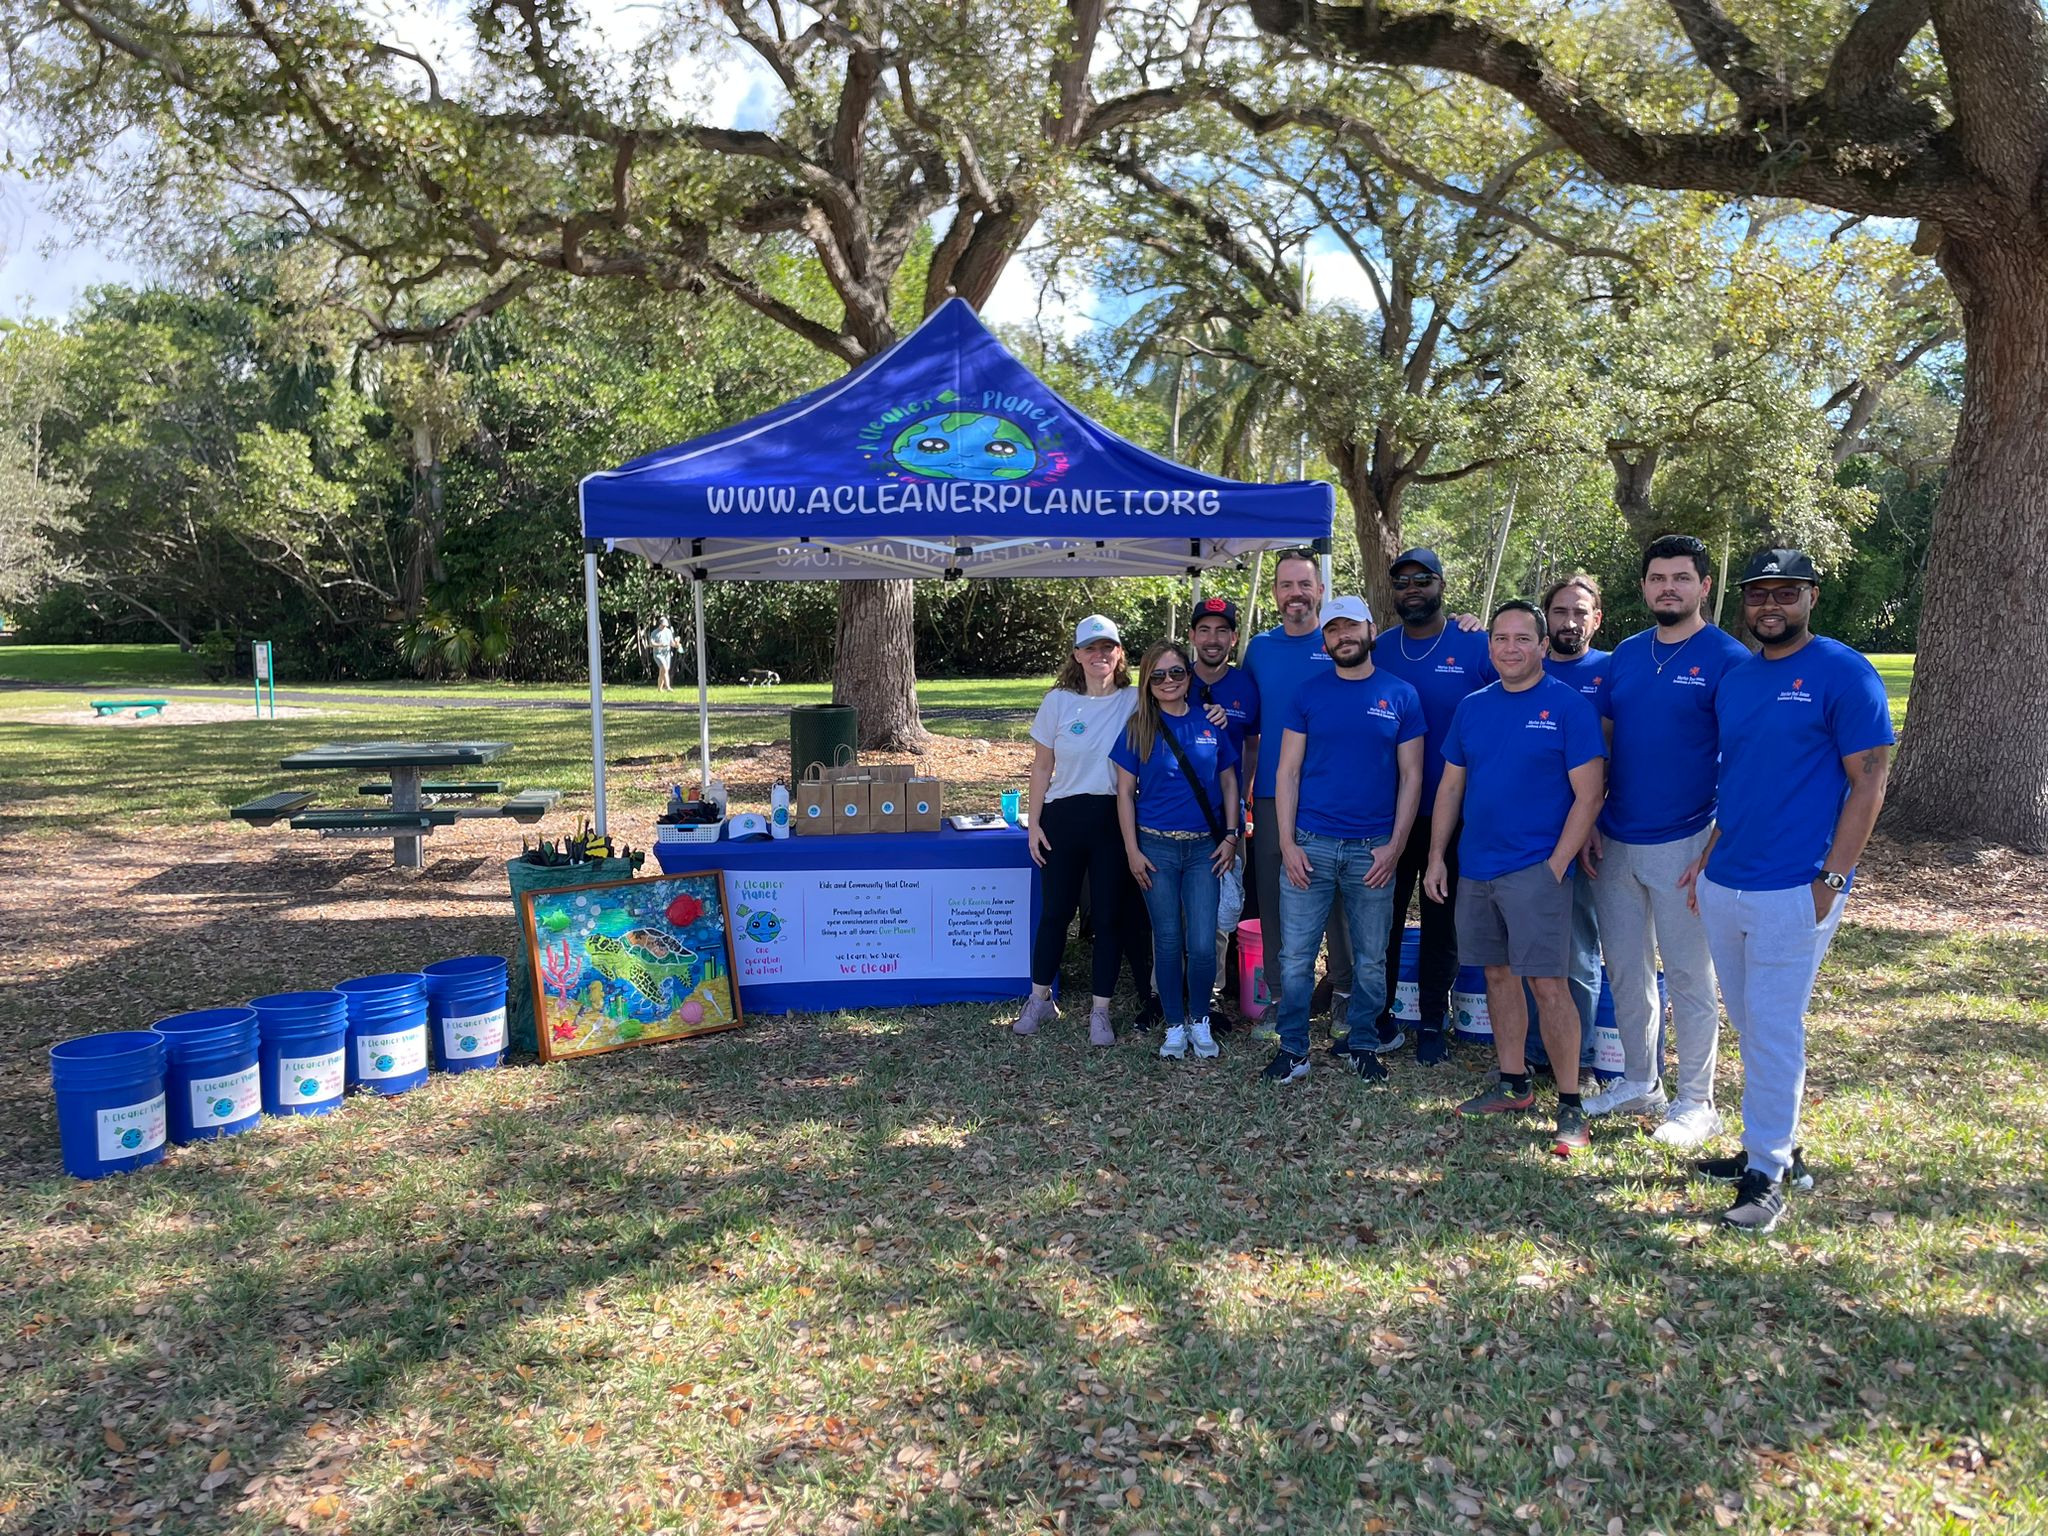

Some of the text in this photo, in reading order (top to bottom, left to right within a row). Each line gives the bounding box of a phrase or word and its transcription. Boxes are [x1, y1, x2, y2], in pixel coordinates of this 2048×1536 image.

[858, 399, 933, 441] Cleaner
[983, 390, 1060, 432] Planet
[706, 482, 1220, 516] WWW.ACLEANERPLANET.ORG
[744, 879, 784, 890] Cleaner
[819, 880, 920, 891] Kids and Community that Clean!
[742, 889, 778, 900] Planet
[833, 908, 862, 917] Promoting
[889, 907, 902, 915] that
[986, 907, 1012, 917] Cleanups
[948, 918, 1013, 928] Operations with special
[821, 928, 837, 938] thing
[879, 926, 893, 935] Our
[947, 929, 972, 937] activities
[969, 938, 985, 946] Mind
[999, 938, 1011, 946] Soul
[745, 956, 781, 966] operation
[745, 967, 754, 975] at
[763, 965, 782, 975] time!
[840, 959, 898, 975] We Clean!
[368, 1038, 399, 1048] Cleaner
[292, 1060, 325, 1072] Cleaner
[204, 1078, 239, 1092] Cleaner
[112, 1107, 149, 1122] Cleaner
